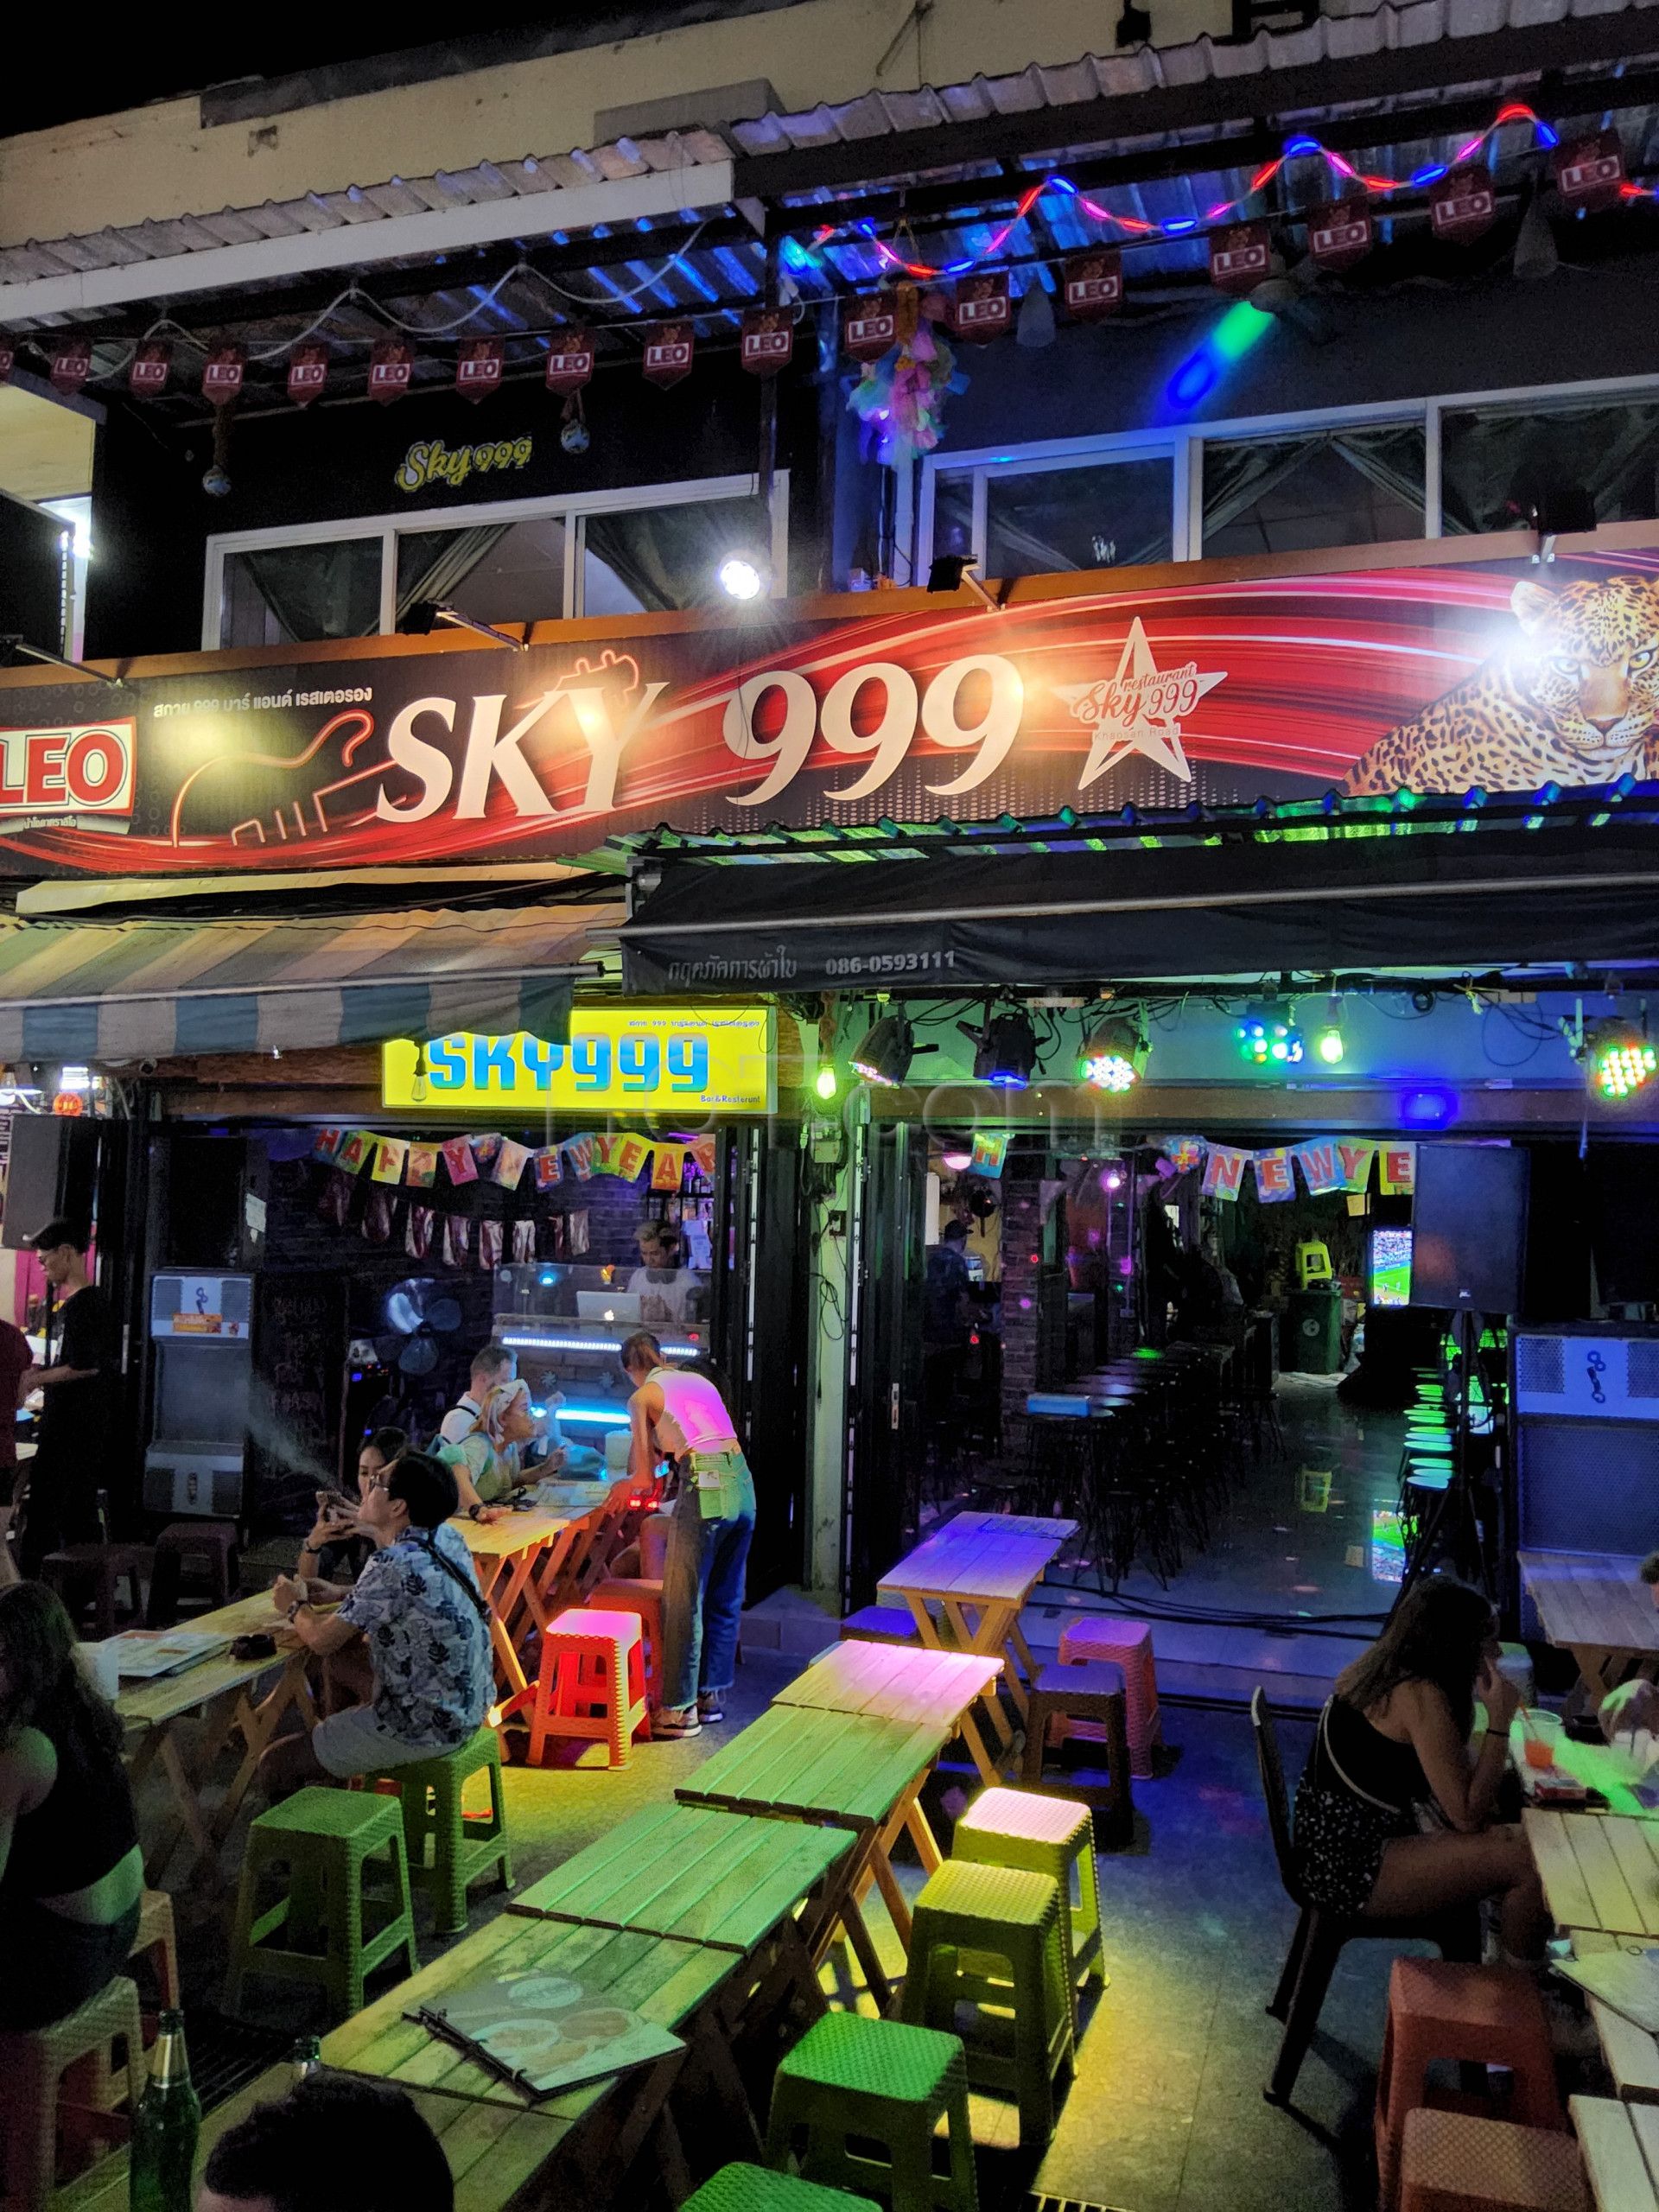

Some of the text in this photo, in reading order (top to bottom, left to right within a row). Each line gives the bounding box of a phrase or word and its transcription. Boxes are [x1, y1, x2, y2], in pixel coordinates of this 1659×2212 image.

[1316, 225, 1364, 249] LEO
[1216, 250, 1265, 271] LEO
[1071, 280, 1116, 302] LEO
[962, 300, 1004, 322] LEO
[851, 318, 893, 341] LEO
[747, 335, 787, 354] LEO
[552, 356, 588, 372] LEO
[649, 346, 688, 364] LEO
[58, 358, 86, 373] LEO
[135, 364, 165, 380] LEO
[208, 366, 238, 382] LEO
[293, 366, 323, 383] LEO
[375, 365, 410, 382] LEO
[462, 362, 498, 378] LEO
[1121, 664, 1195, 691] restaurant
[194, 699, 219, 713] 999
[223, 691, 251, 712] บาร์
[253, 688, 292, 709] แอนด์
[1073, 679, 1198, 728] Sky 999
[376, 653, 1026, 823] SKY 999
